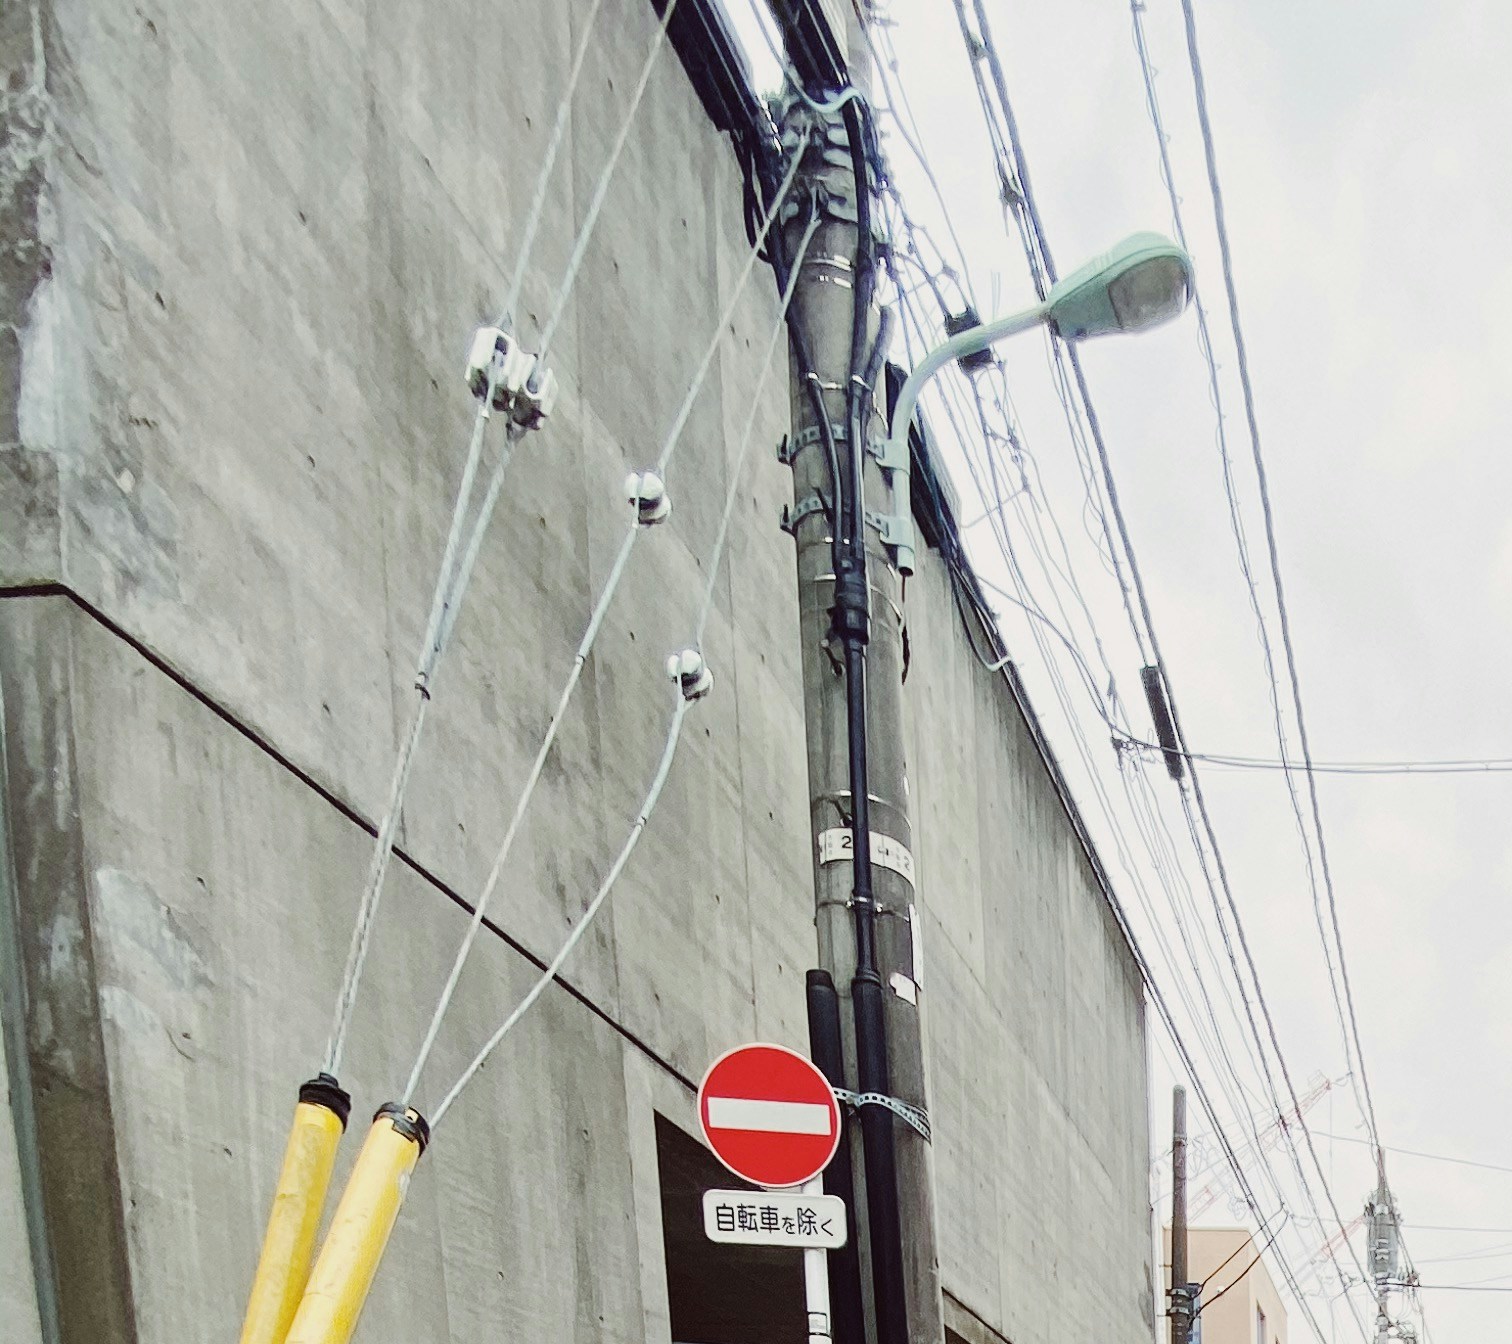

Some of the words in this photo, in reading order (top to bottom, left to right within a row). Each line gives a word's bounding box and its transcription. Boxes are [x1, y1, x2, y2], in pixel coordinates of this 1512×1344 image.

[715, 1203, 834, 1237] 自転車を除く
